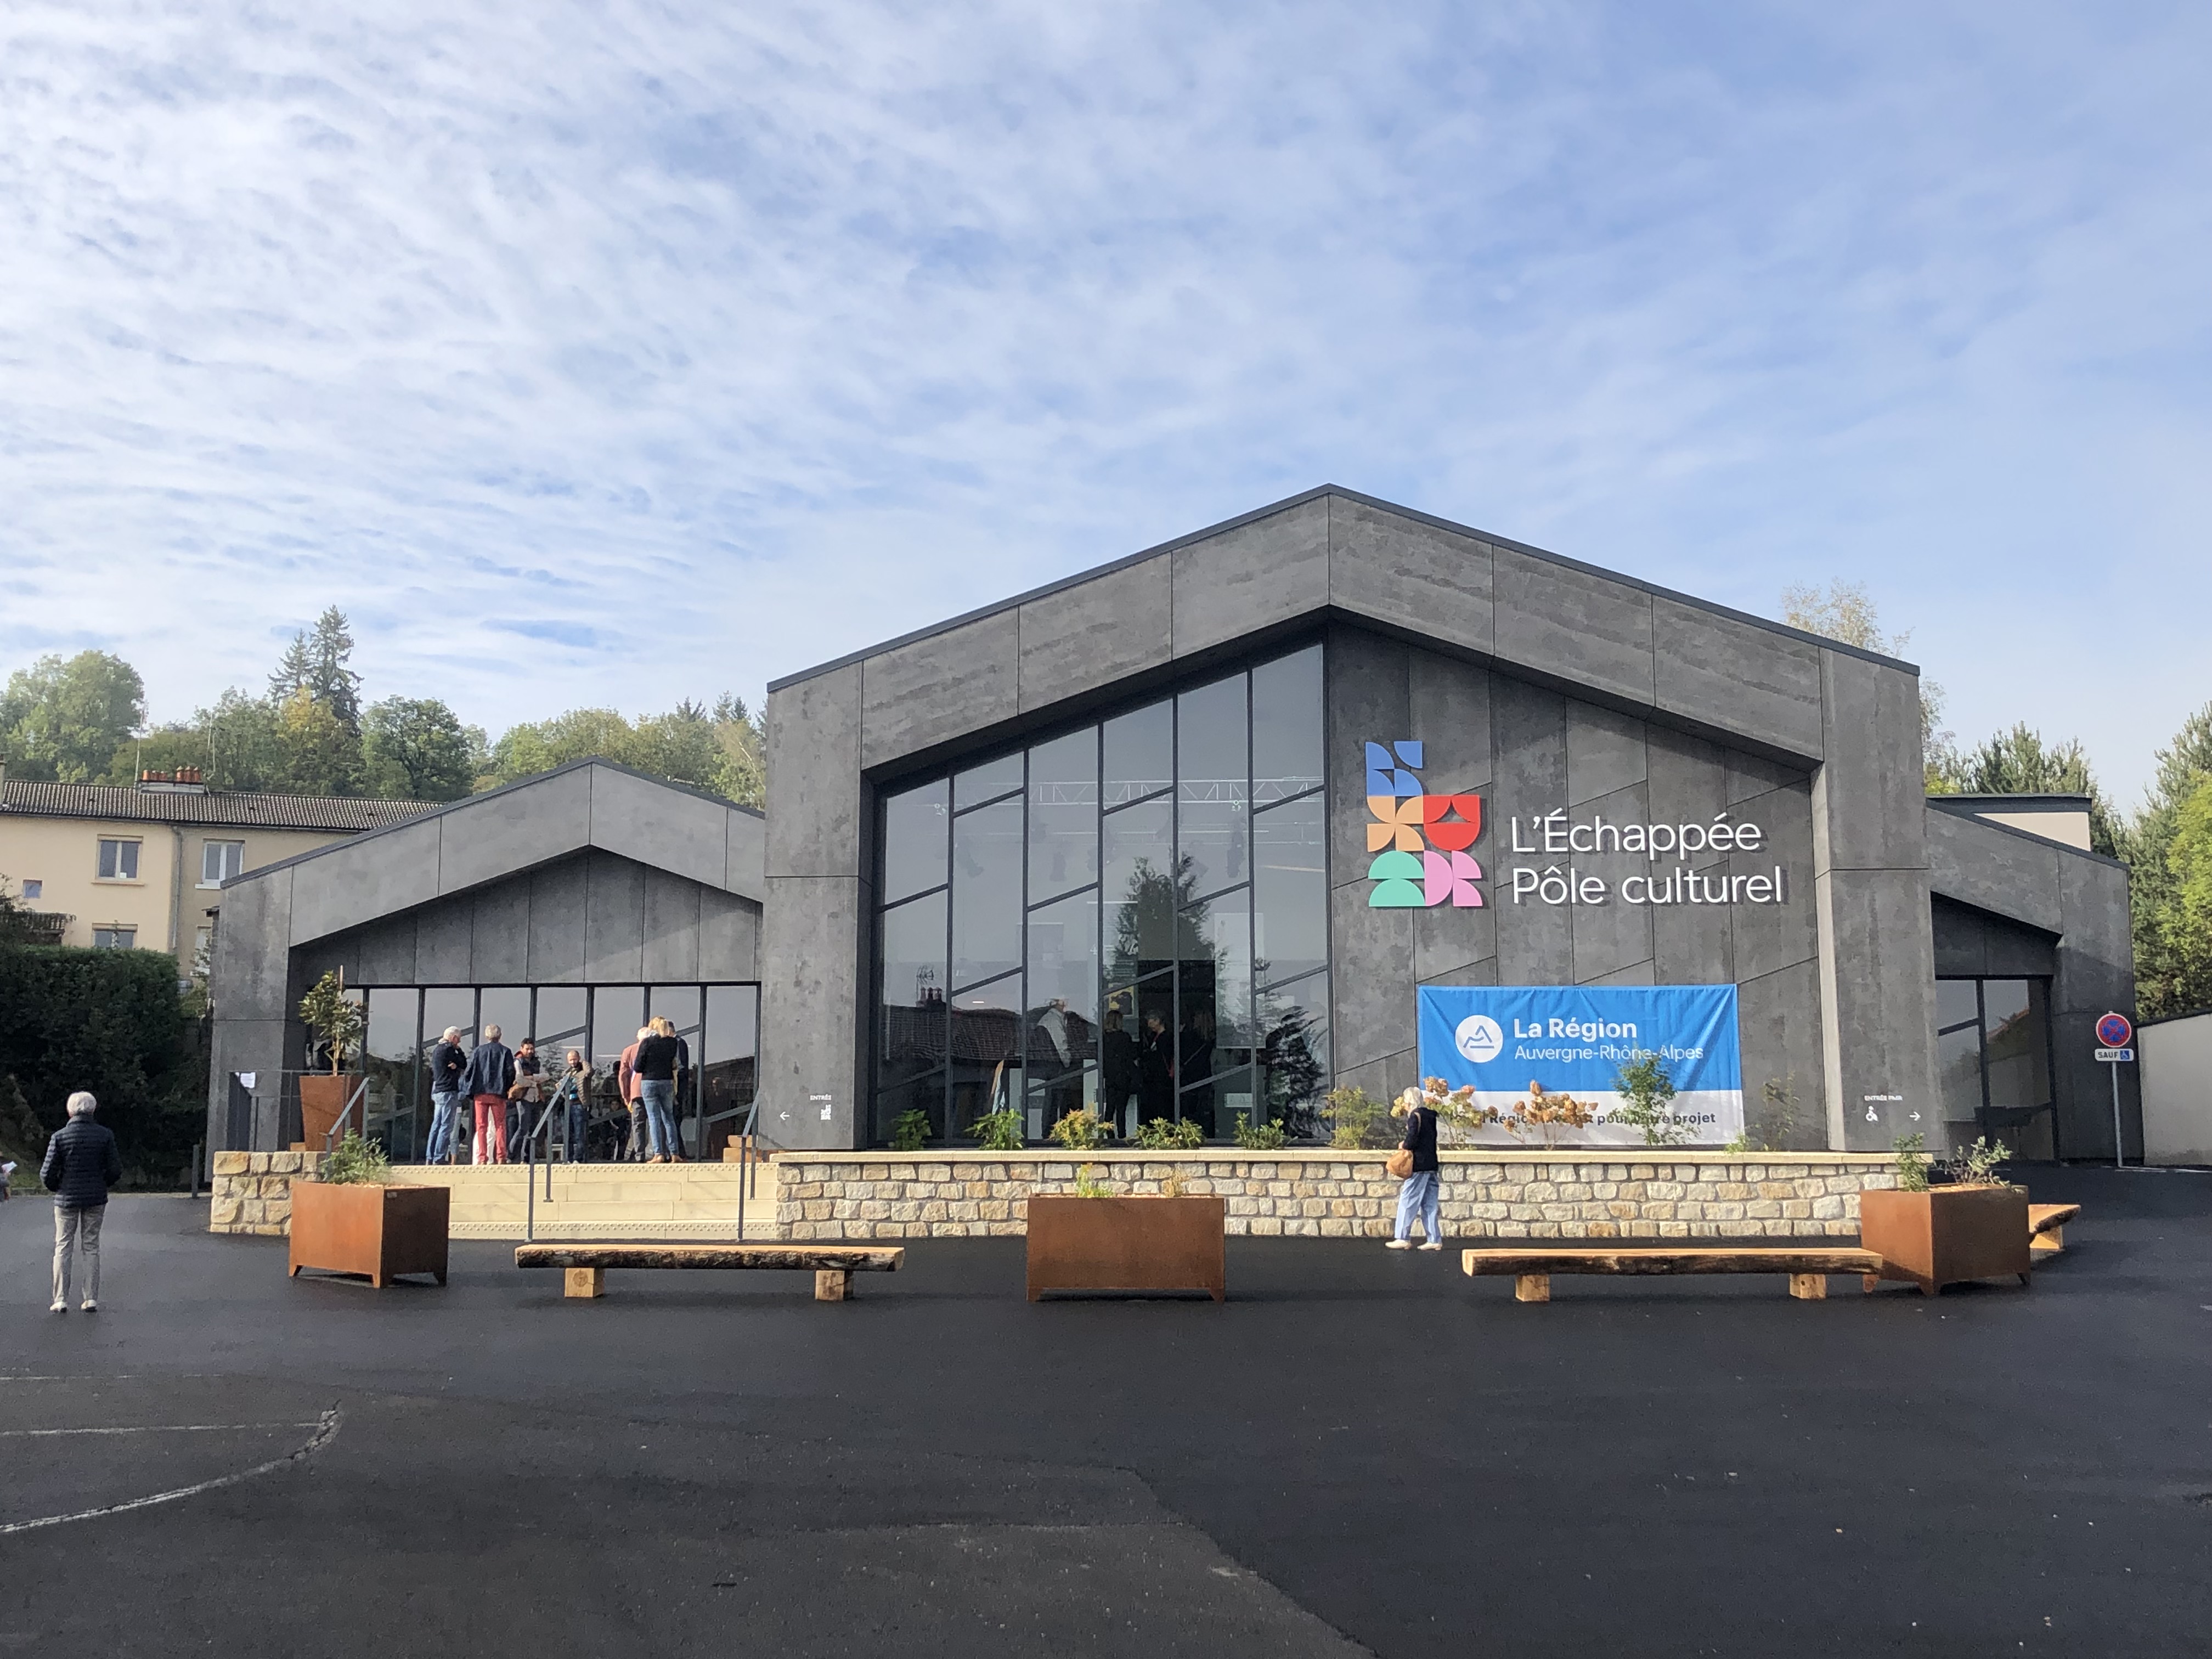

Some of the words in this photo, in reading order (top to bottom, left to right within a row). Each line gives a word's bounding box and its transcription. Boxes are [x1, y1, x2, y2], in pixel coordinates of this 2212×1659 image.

[1513, 865, 1605, 904] Pôle
[1622, 865, 1782, 904] culturel
[1513, 1018, 1542, 1039] La
[1549, 1017, 1638, 1042] Région
[1673, 1111, 1716, 1126] projet
